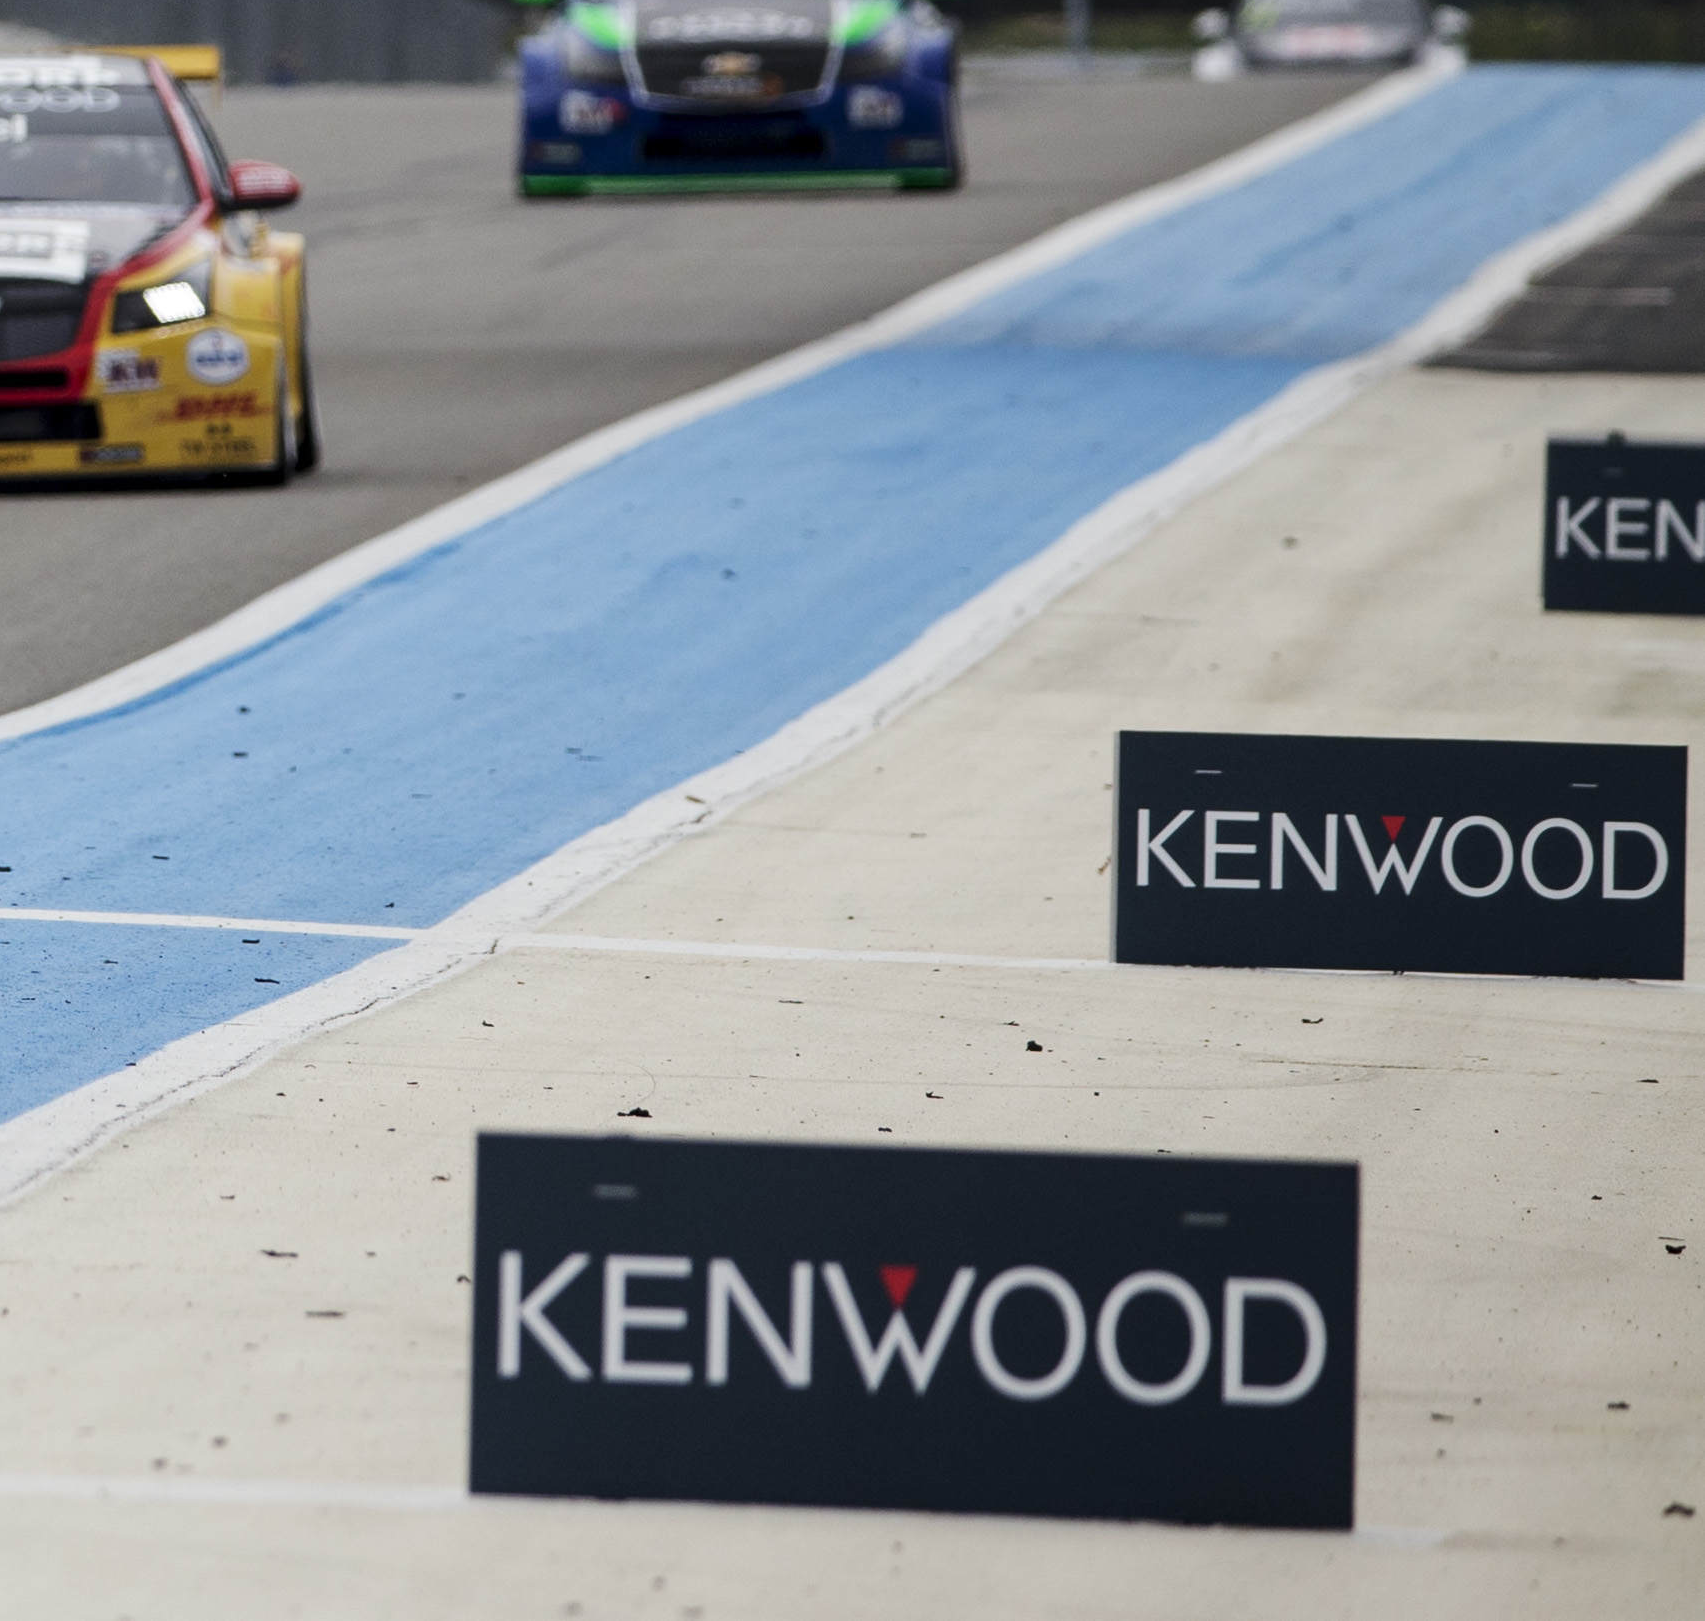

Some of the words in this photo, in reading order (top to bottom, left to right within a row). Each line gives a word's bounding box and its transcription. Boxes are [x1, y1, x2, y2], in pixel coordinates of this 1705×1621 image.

[1554, 495, 1705, 563] KEN
[1135, 807, 1670, 901] KENWOOD
[496, 1249, 1328, 1406] KENWOOD
